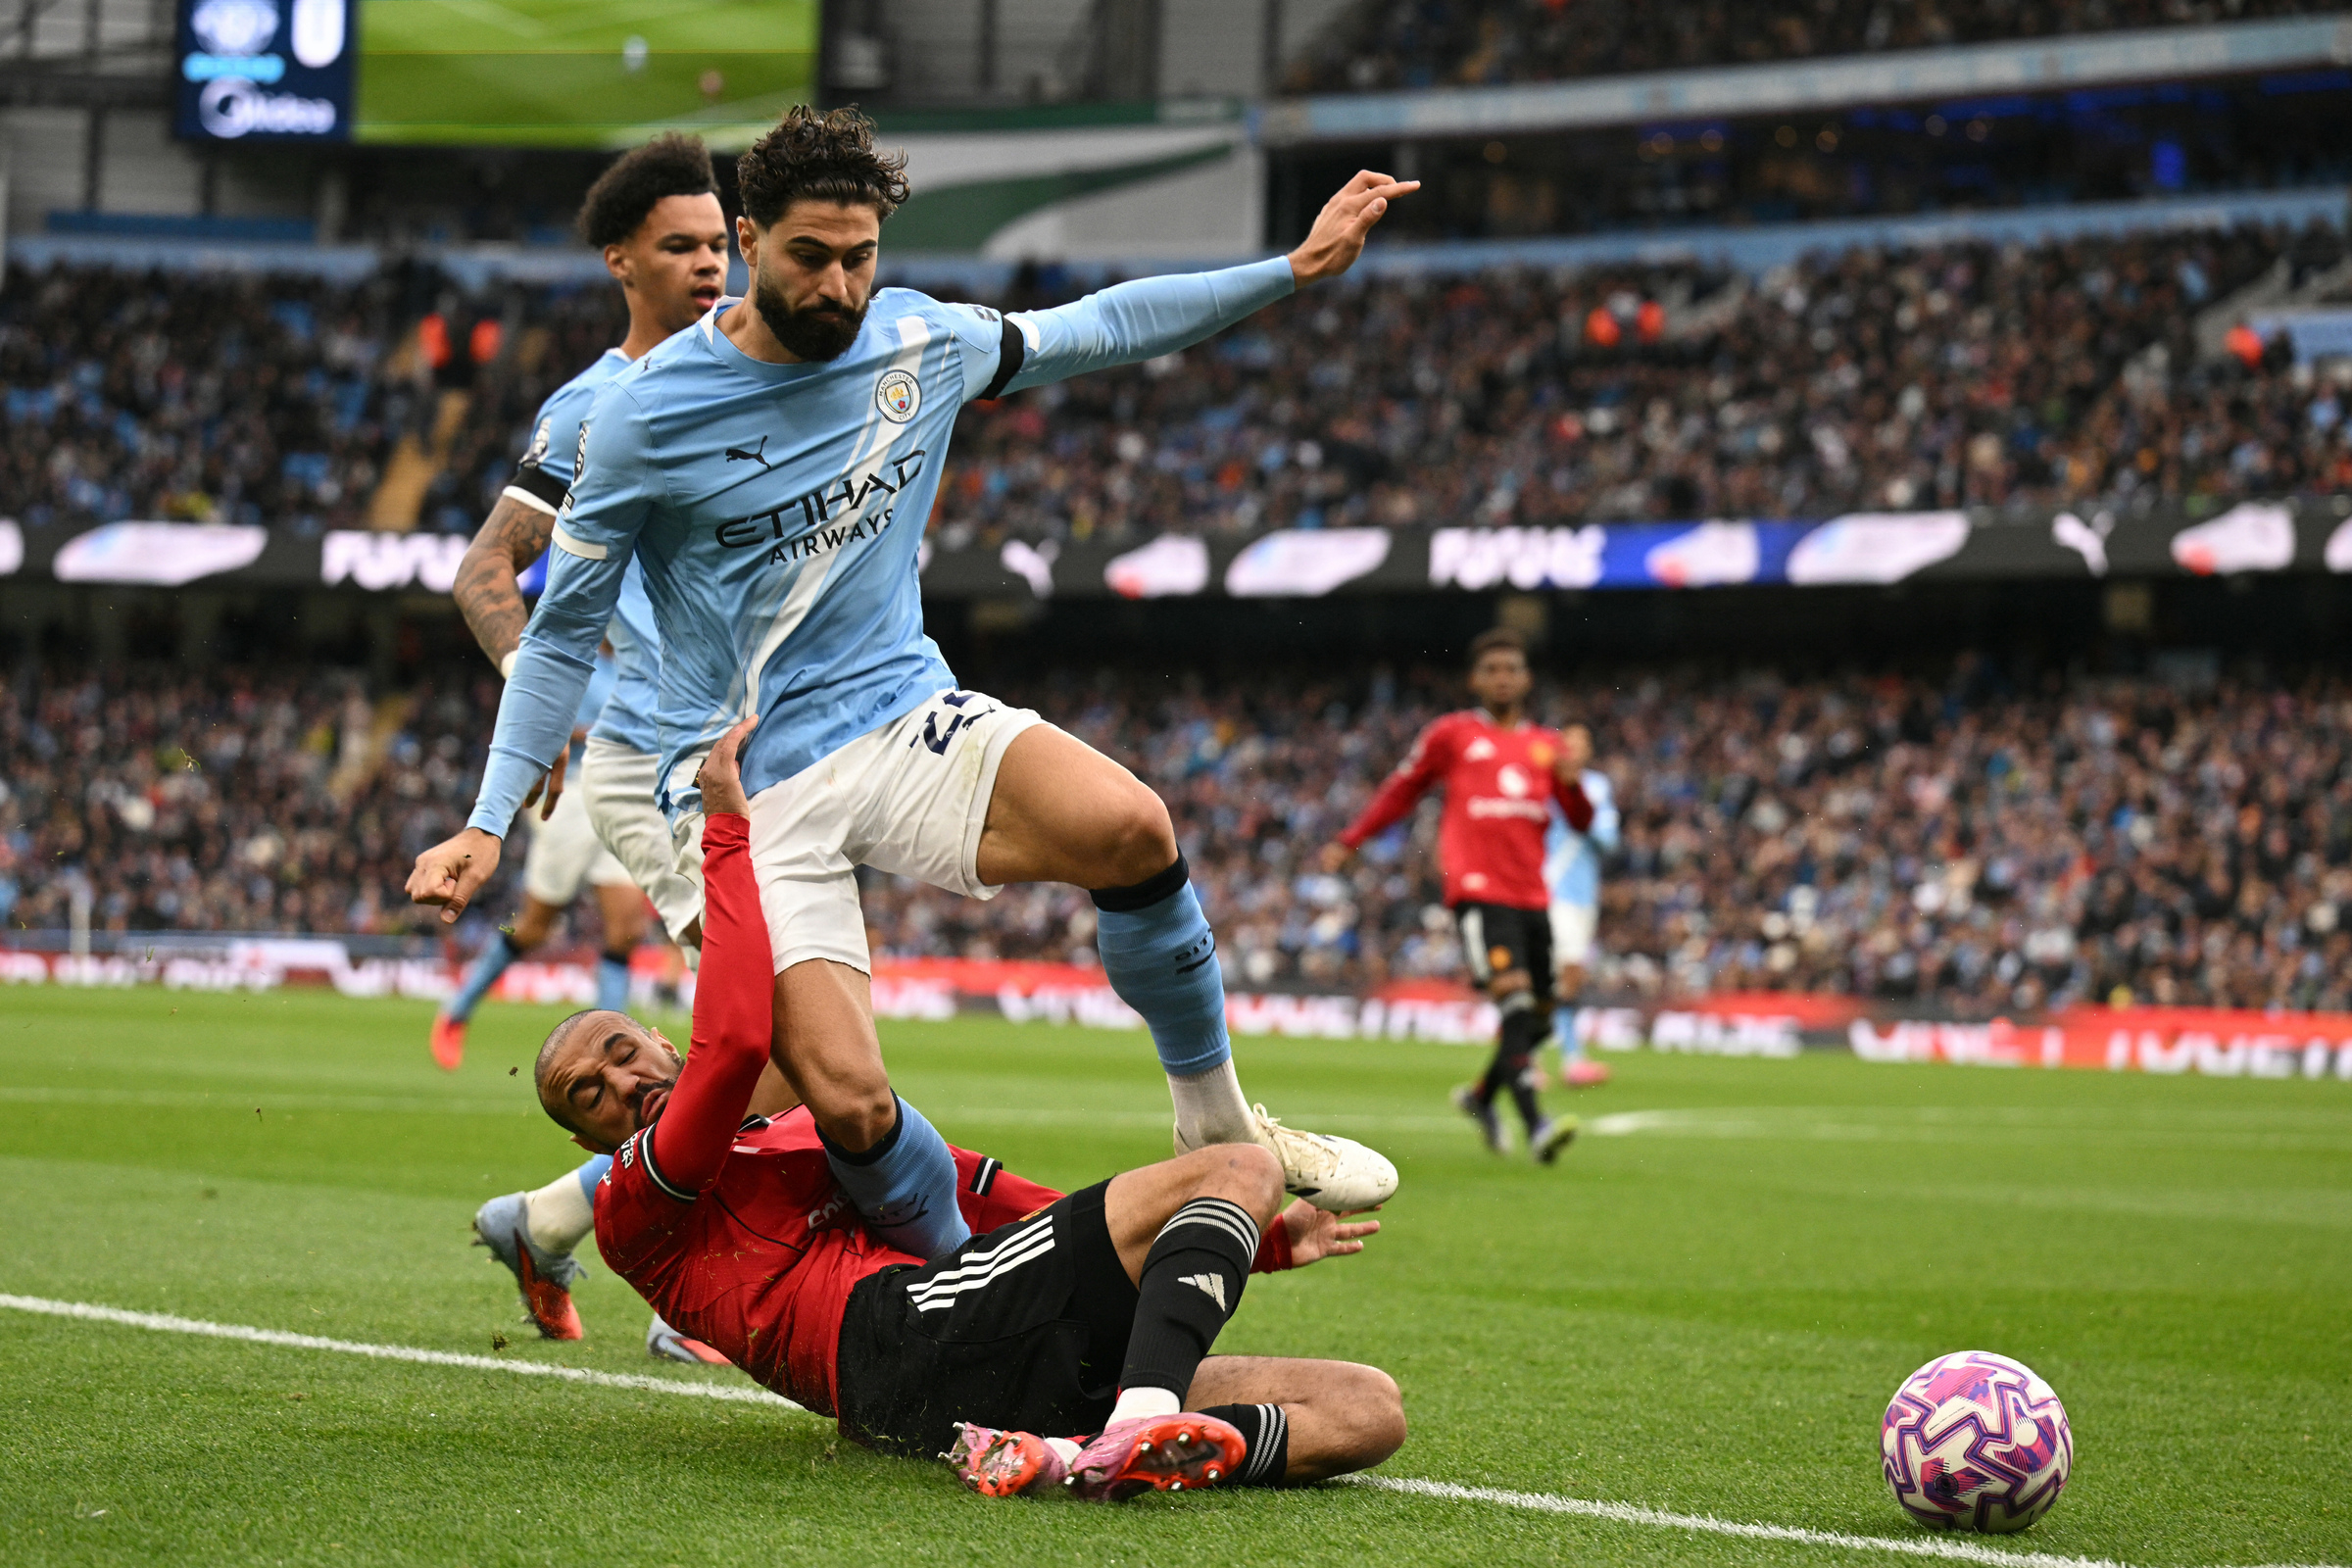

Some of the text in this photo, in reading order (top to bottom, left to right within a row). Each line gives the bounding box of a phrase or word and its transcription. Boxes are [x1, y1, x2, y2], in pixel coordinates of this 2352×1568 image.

[879, 373, 913, 397] MANCHESTER
[898, 412, 911, 421] CITY
[715, 449, 925, 549] ETIHAD
[770, 508, 893, 565] AIRWAYS
